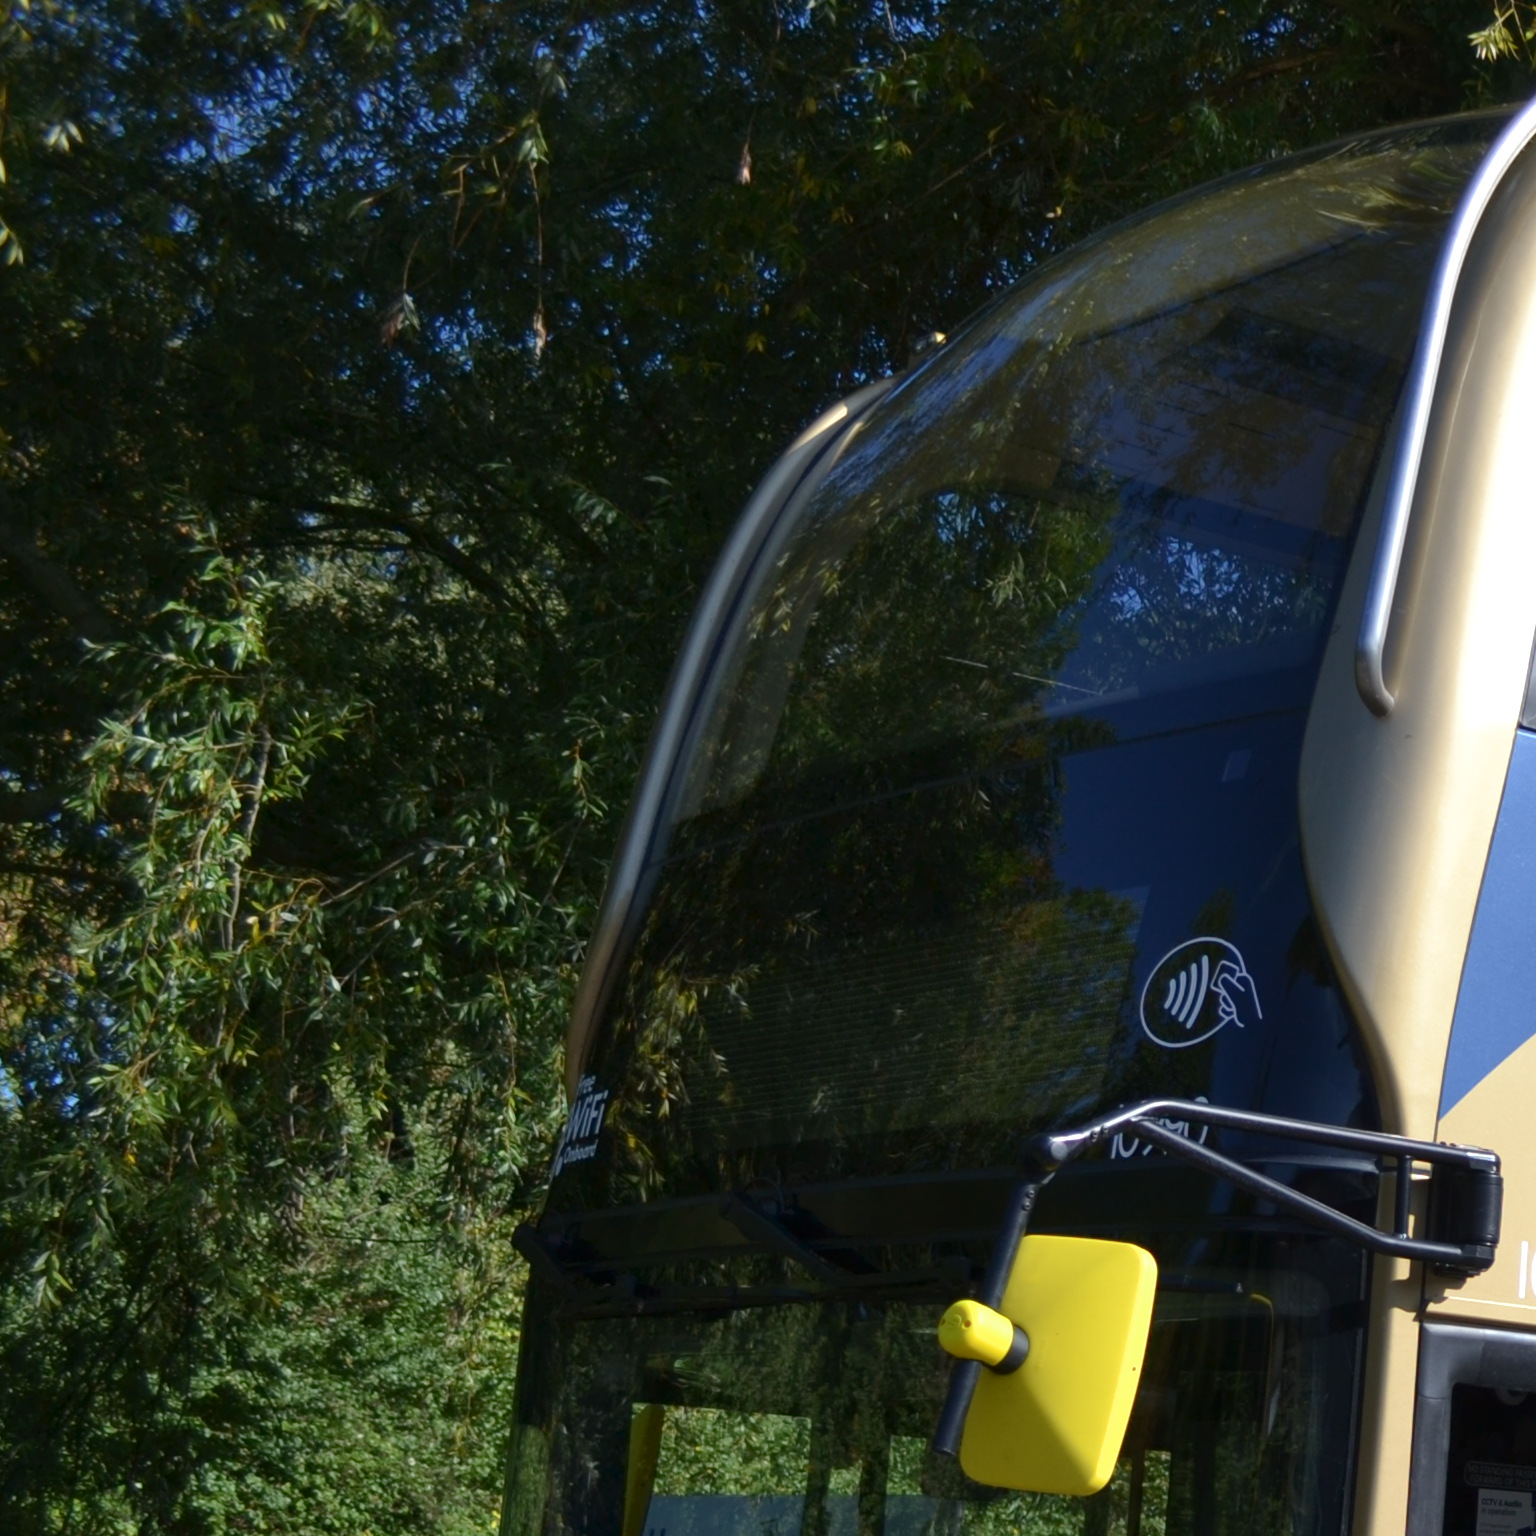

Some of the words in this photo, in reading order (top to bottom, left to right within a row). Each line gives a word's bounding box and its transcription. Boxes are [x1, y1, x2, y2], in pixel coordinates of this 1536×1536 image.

[565, 1089, 609, 1143] WiFi
[1481, 1498, 1498, 1506] CCTV
[1504, 1499, 1523, 1508] Audio
